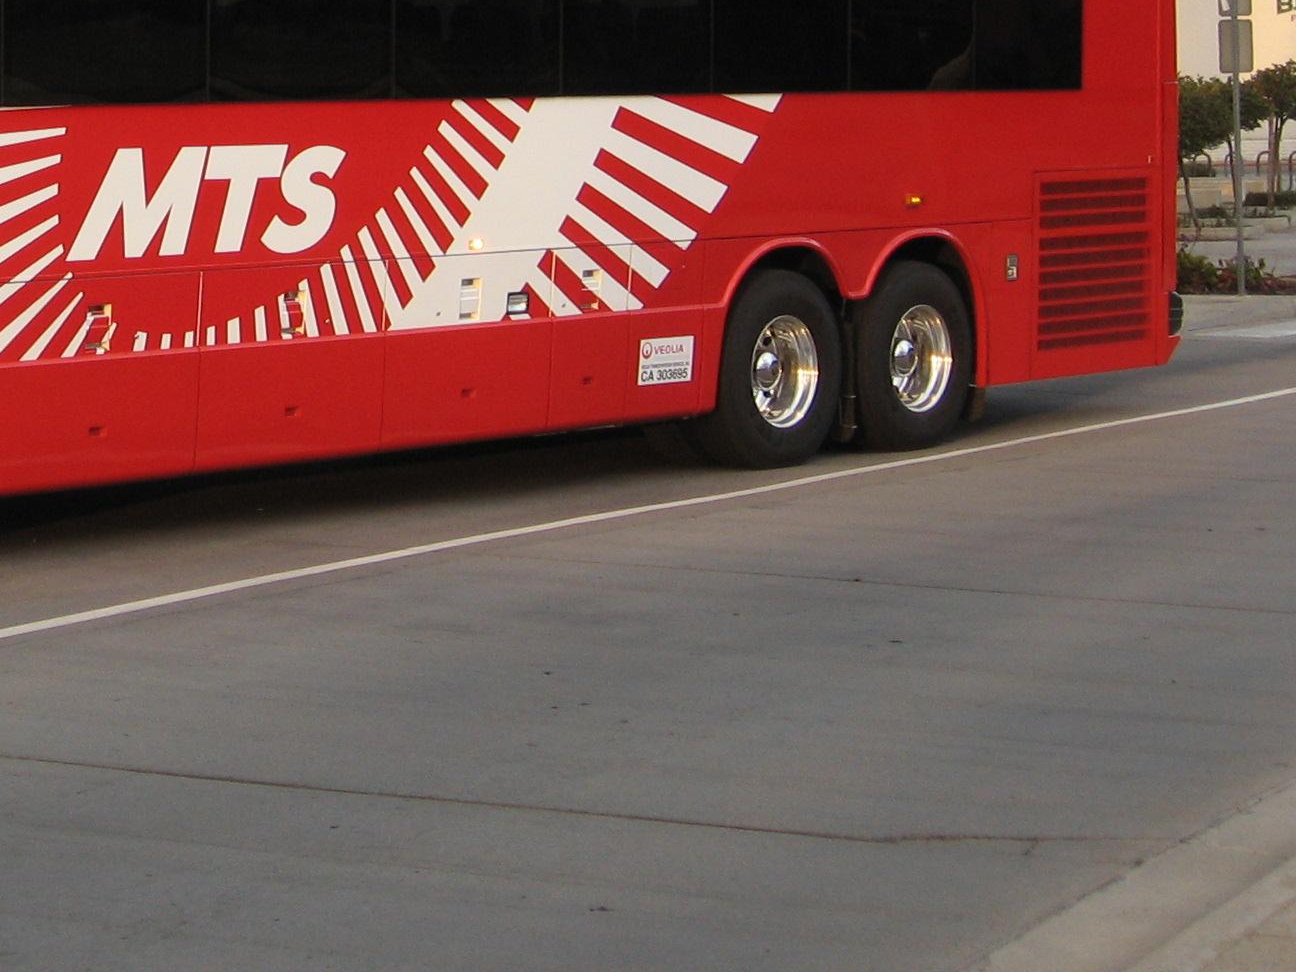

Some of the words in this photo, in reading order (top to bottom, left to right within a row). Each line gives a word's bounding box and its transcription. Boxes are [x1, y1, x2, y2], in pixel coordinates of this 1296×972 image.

[65, 143, 348, 262] MTS
[654, 344, 684, 355] VEOLIA
[641, 370, 654, 382] CA
